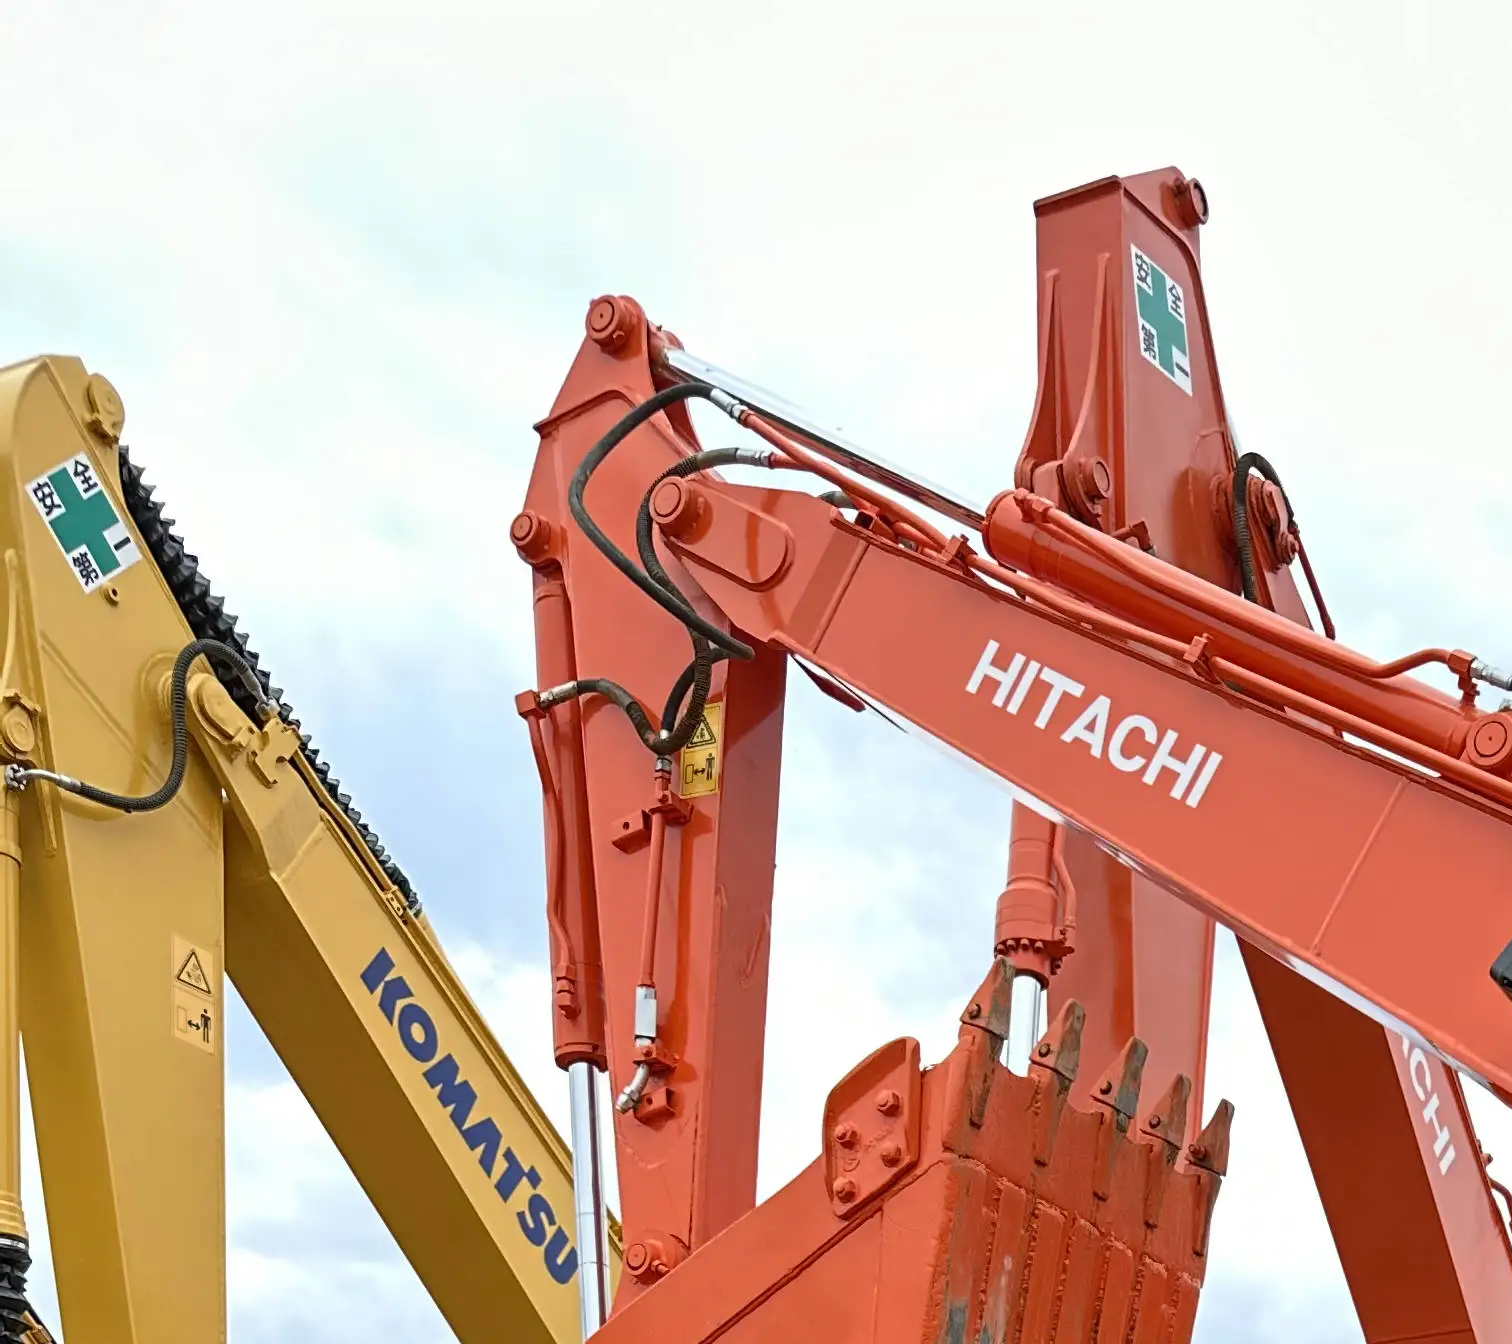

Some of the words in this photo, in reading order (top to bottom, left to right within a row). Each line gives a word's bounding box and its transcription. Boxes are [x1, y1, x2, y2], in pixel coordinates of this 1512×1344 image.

[965, 638, 1224, 810] HITACHI
[359, 946, 580, 1285] KOMATSU
[1401, 1034, 1456, 1176] CHI
